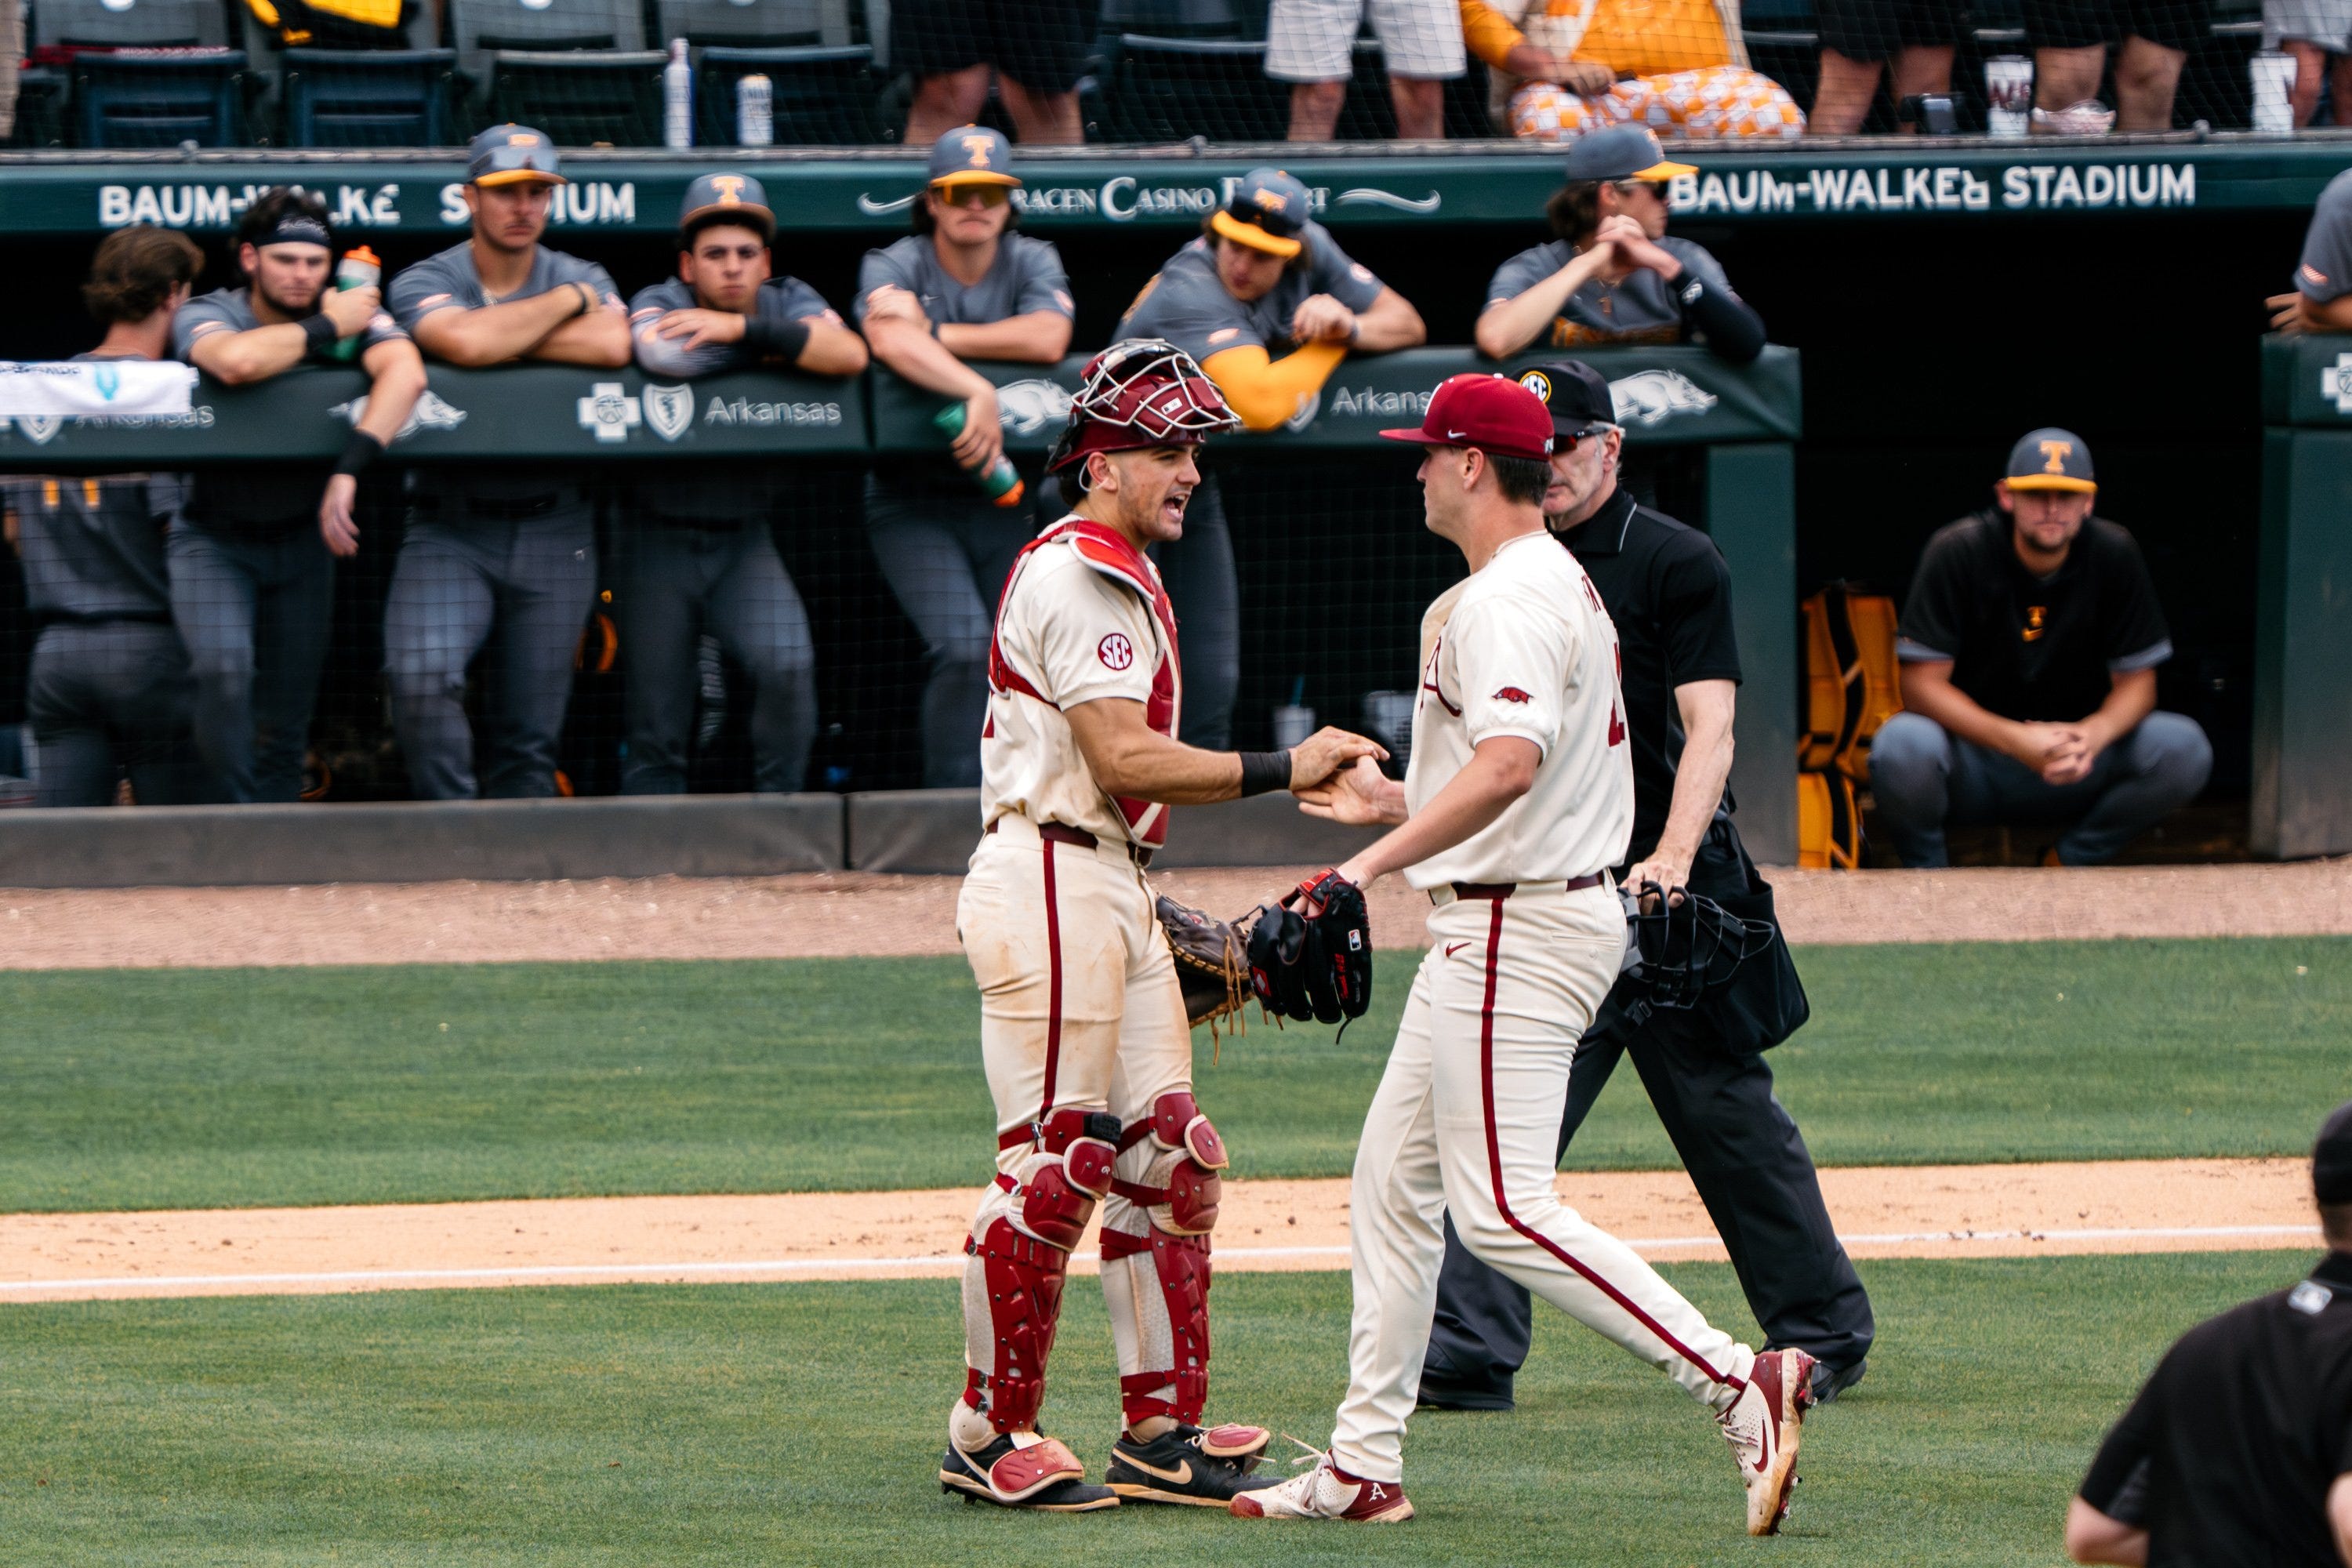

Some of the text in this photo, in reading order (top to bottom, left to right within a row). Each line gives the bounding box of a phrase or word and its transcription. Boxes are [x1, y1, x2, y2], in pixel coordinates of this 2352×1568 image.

[961, 135, 996, 167] T
[712, 175, 746, 208] T
[1101, 176, 1216, 222] CASINO
[2002, 163, 2196, 209] STADIUM
[704, 396, 843, 427] Arkansas
[2040, 440, 2072, 474] T
[1098, 633, 1132, 670] SEC
[1368, 1482, 1388, 1502] A
